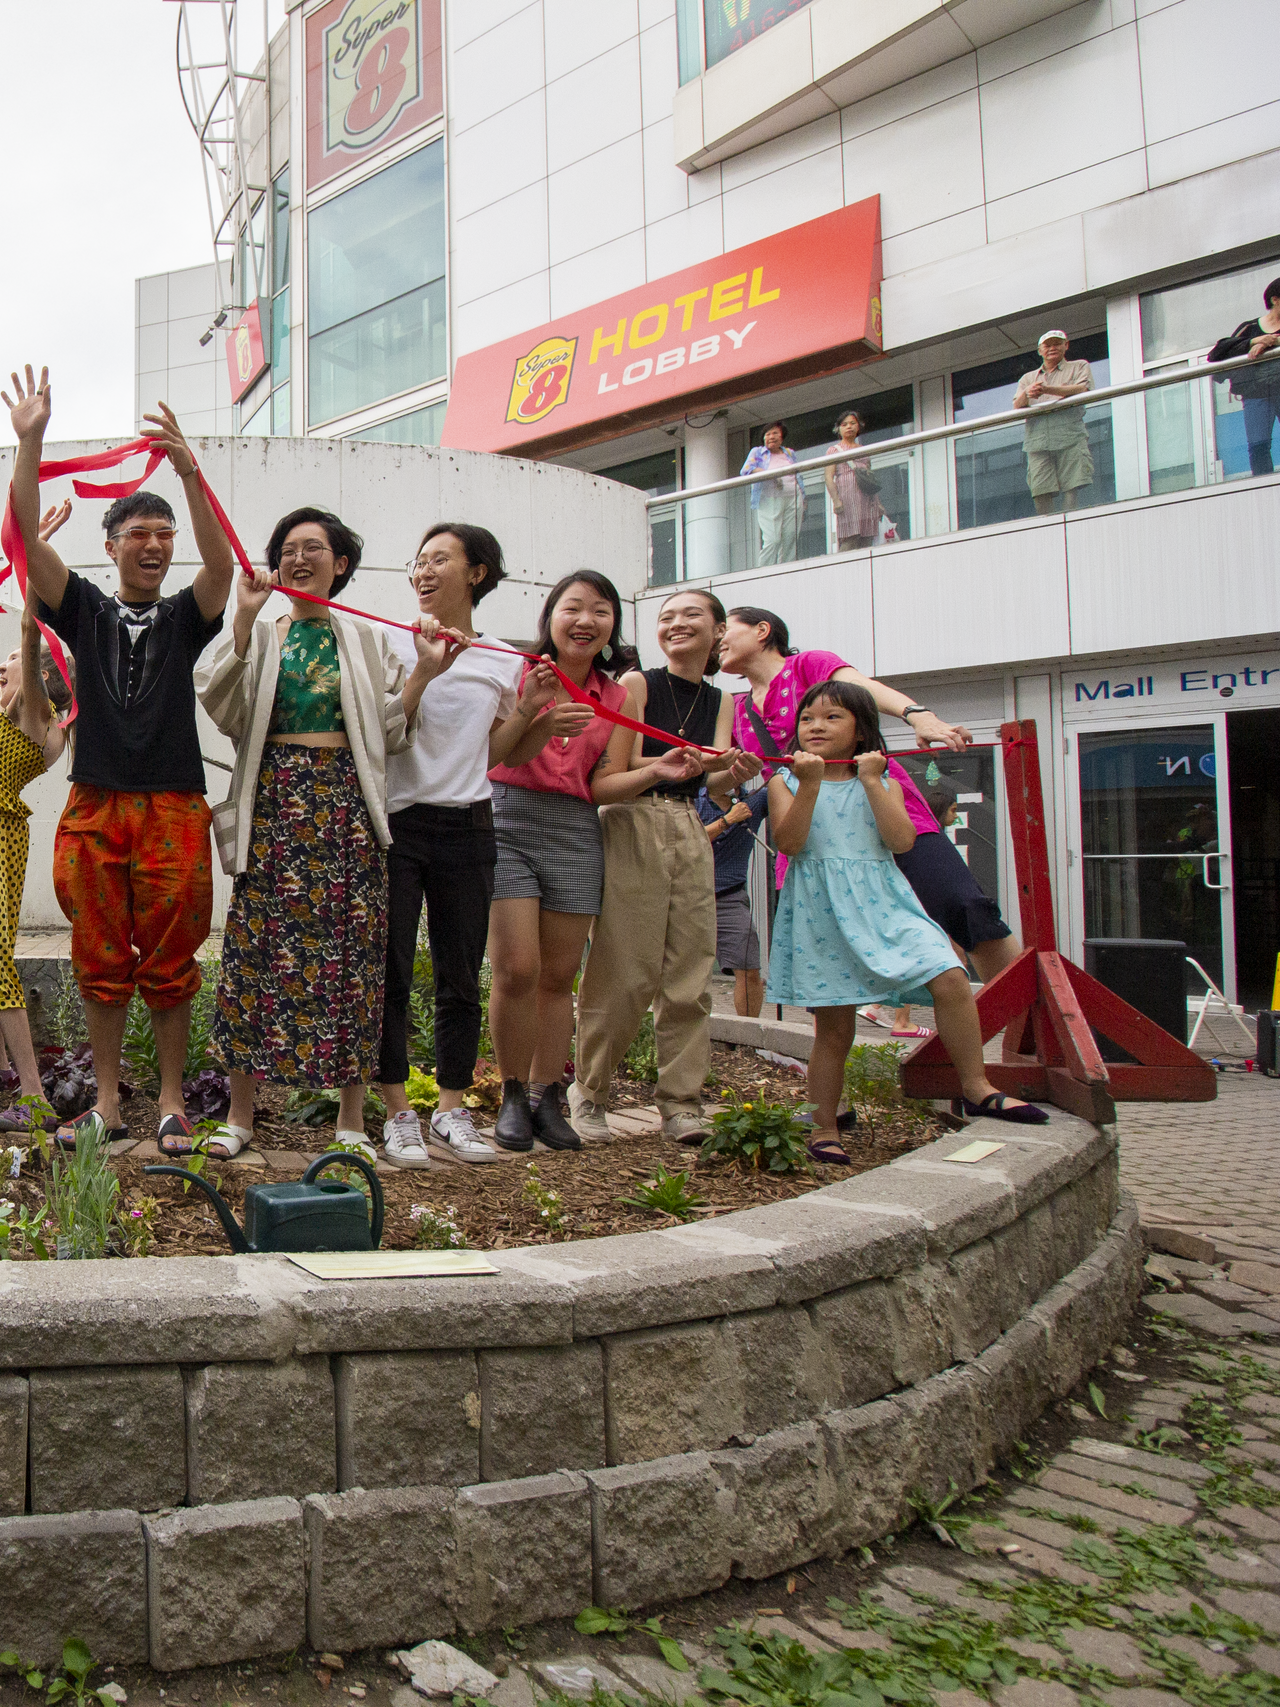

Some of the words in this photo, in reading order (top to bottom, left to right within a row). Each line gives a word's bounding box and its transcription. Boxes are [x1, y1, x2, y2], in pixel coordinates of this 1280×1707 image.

[334, 1, 411, 68] Super
[344, 26, 410, 135] 8
[589, 266, 781, 365] HOTEL
[517, 350, 572, 383] Super
[517, 364, 569, 418] 8
[597, 321, 758, 395] LOBBY
[1075, 675, 1154, 702] Mall
